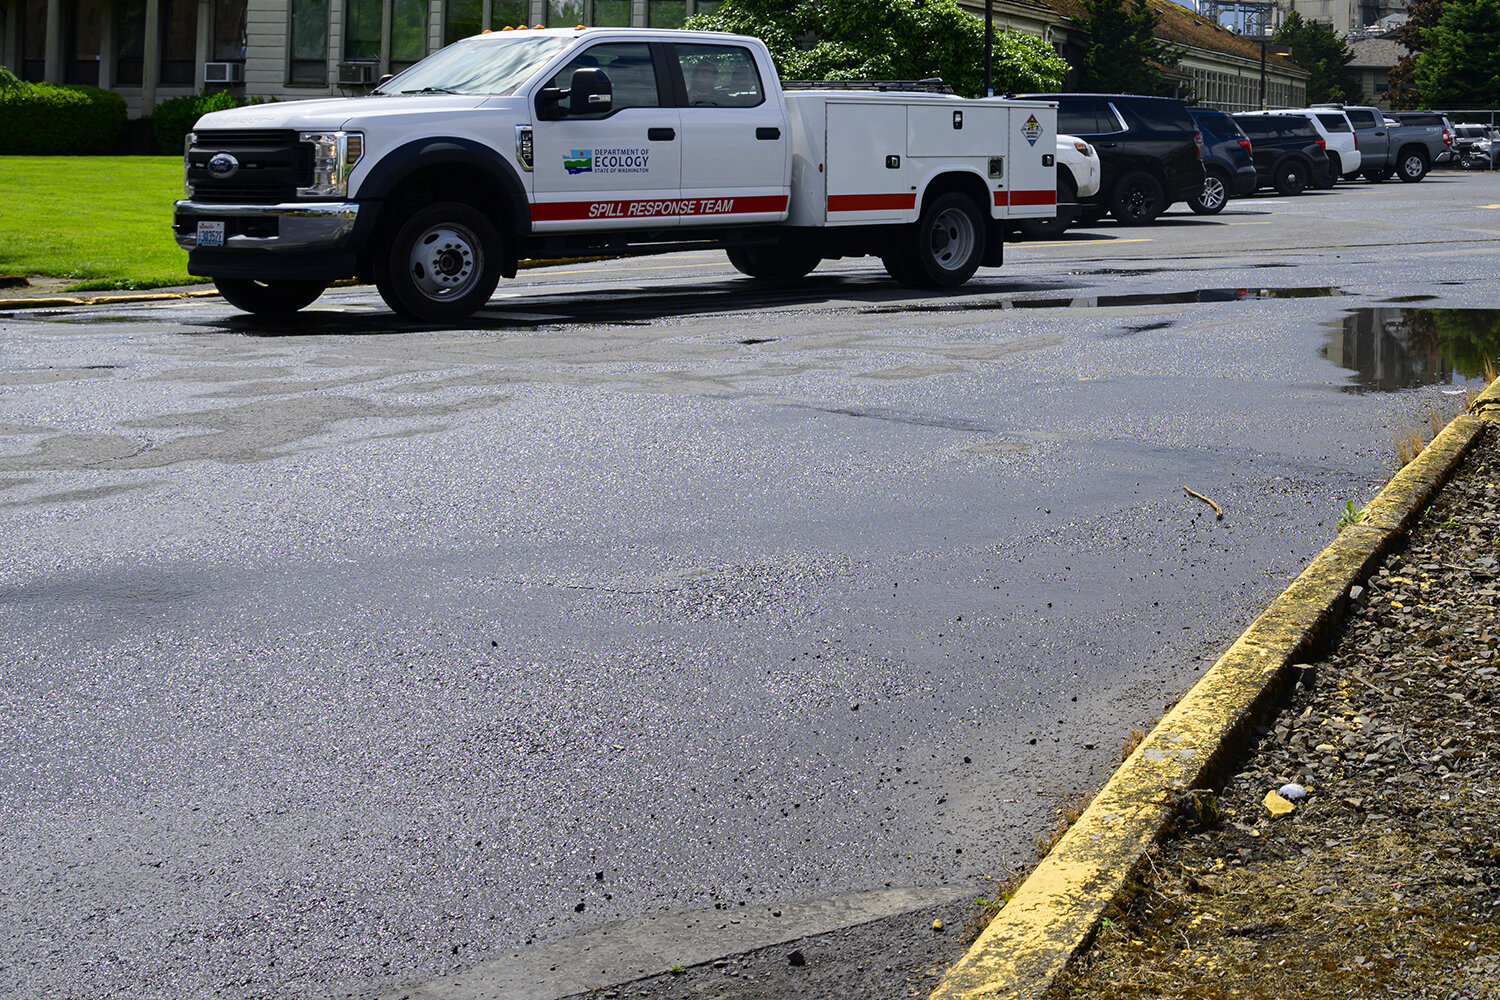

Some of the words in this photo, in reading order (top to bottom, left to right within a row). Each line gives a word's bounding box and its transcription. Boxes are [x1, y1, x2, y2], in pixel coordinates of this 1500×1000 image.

[594, 148, 639, 156] DEPARTMENT
[640, 148, 649, 156] OF
[594, 156, 649, 167] ECOLOGY
[588, 203, 624, 217] SPILL
[628, 200, 697, 216] RESPONSE
[699, 199, 734, 213] TEAM
